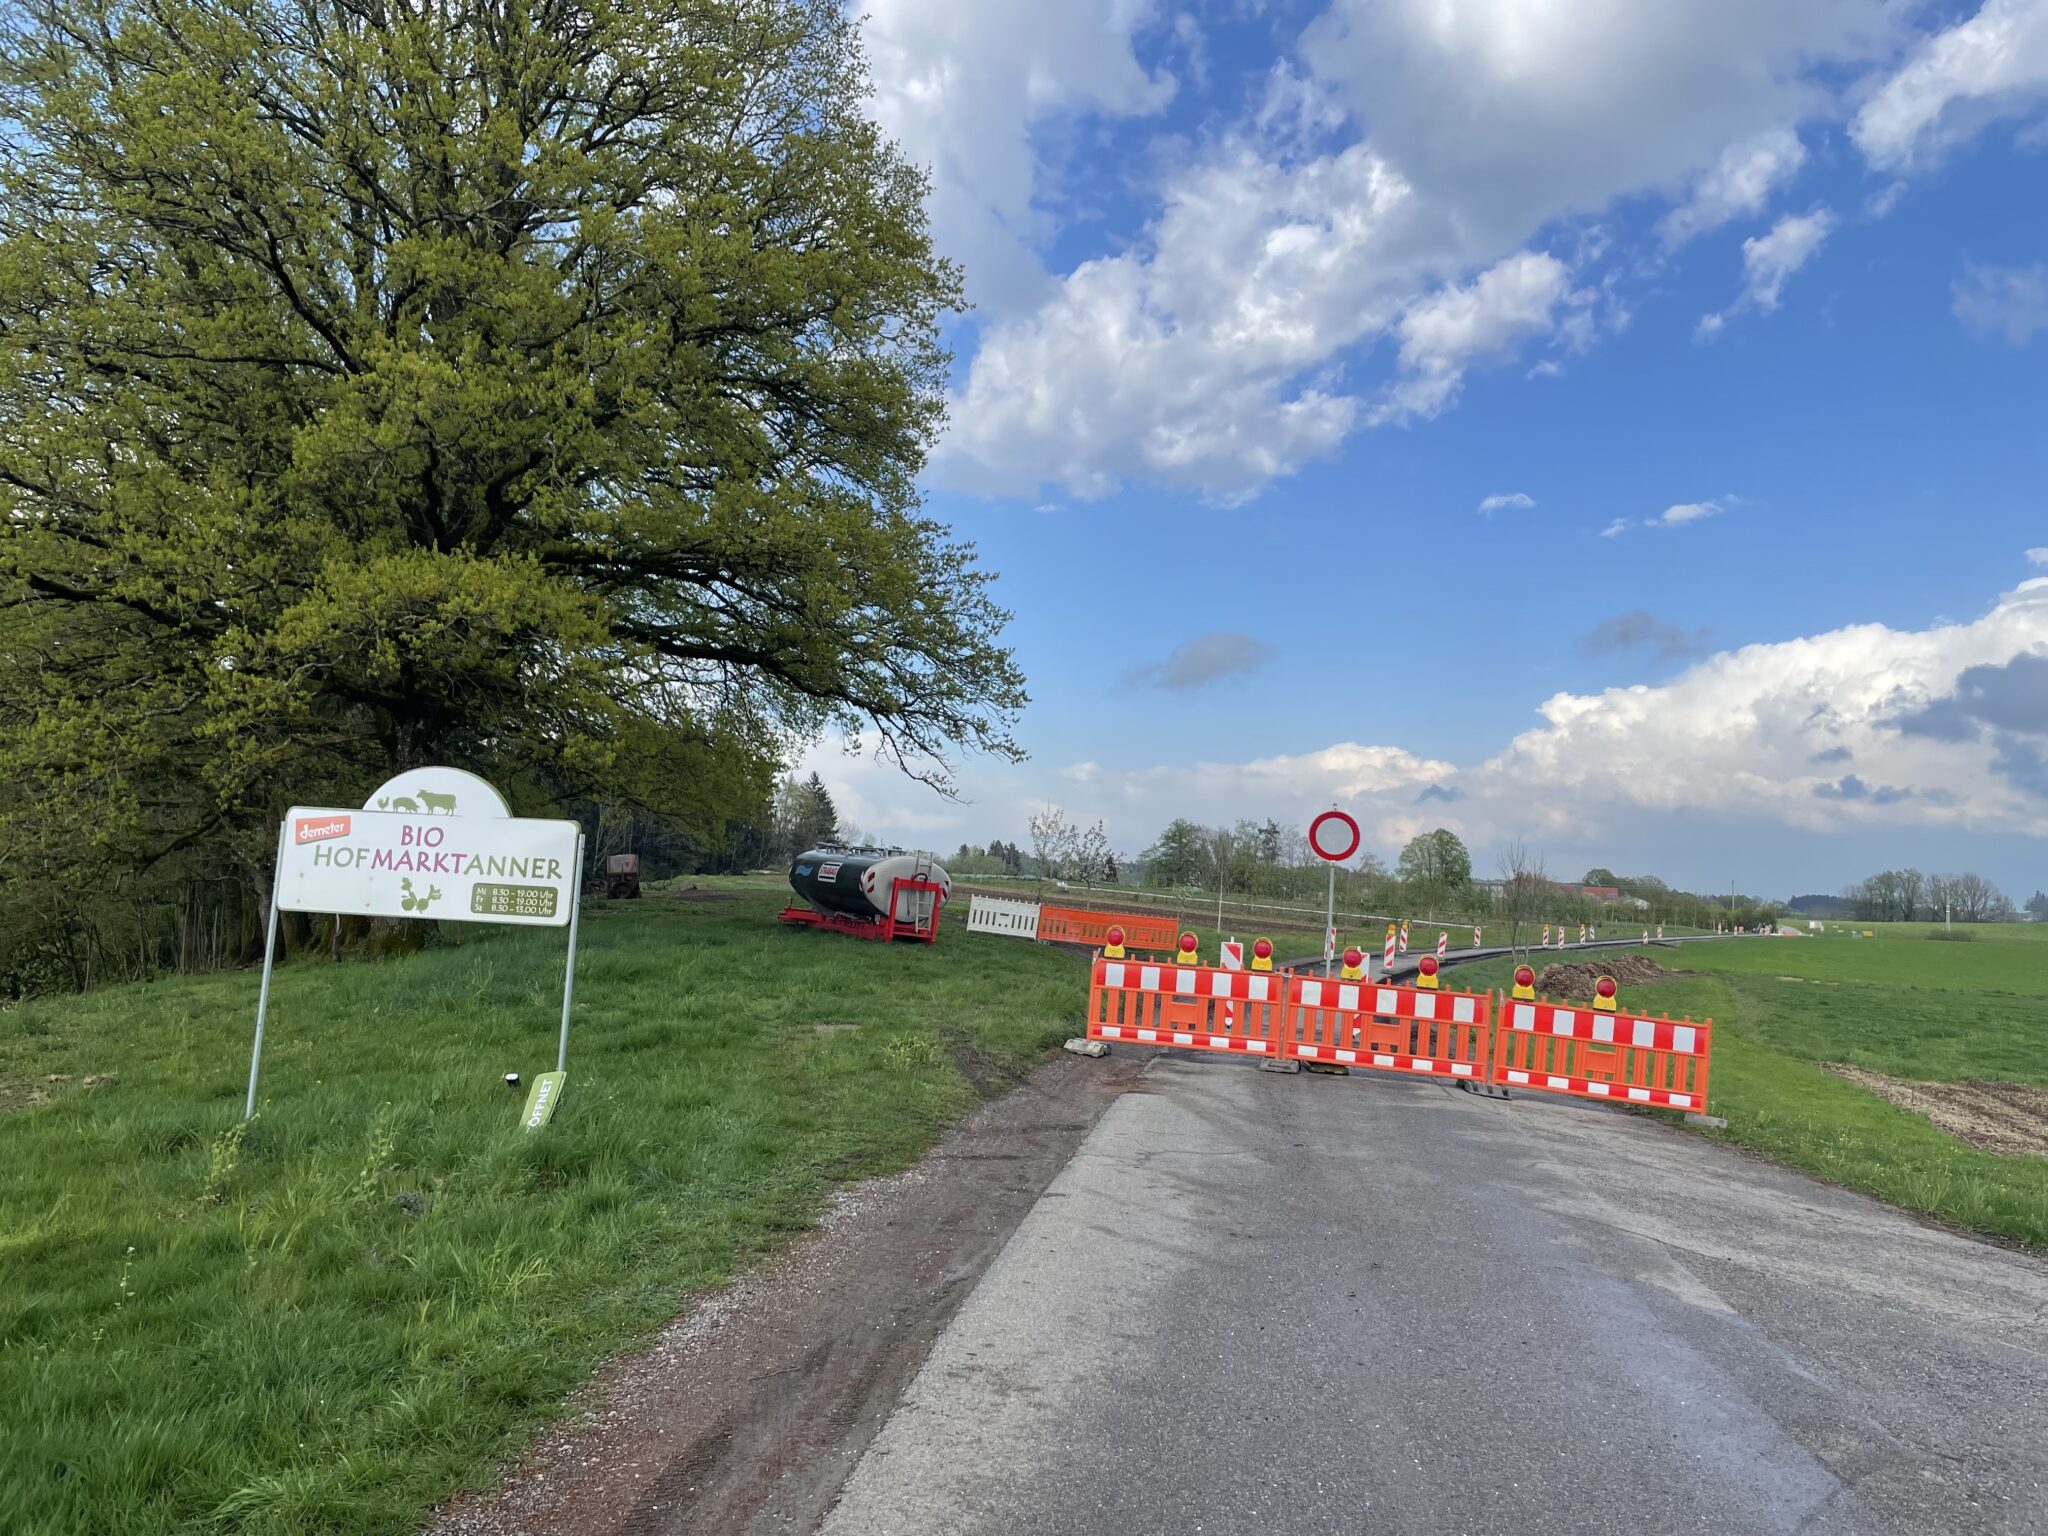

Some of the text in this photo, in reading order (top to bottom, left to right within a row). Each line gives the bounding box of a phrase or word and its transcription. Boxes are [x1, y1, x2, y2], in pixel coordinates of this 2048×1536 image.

[299, 822, 345, 839] demeter
[400, 825, 445, 848] BIO
[476, 887, 487, 896] Mi
[516, 889, 539, 898] 19.00
[539, 890, 554, 899] Uhr
[475, 895, 484, 903] Fr
[491, 895, 509, 904] 8.30
[516, 897, 538, 906] 19.00
[539, 898, 553, 907] Uhr
[474, 903, 483, 912] Sa
[491, 904, 508, 912] 8.30
[538, 906, 552, 915] Uhr
